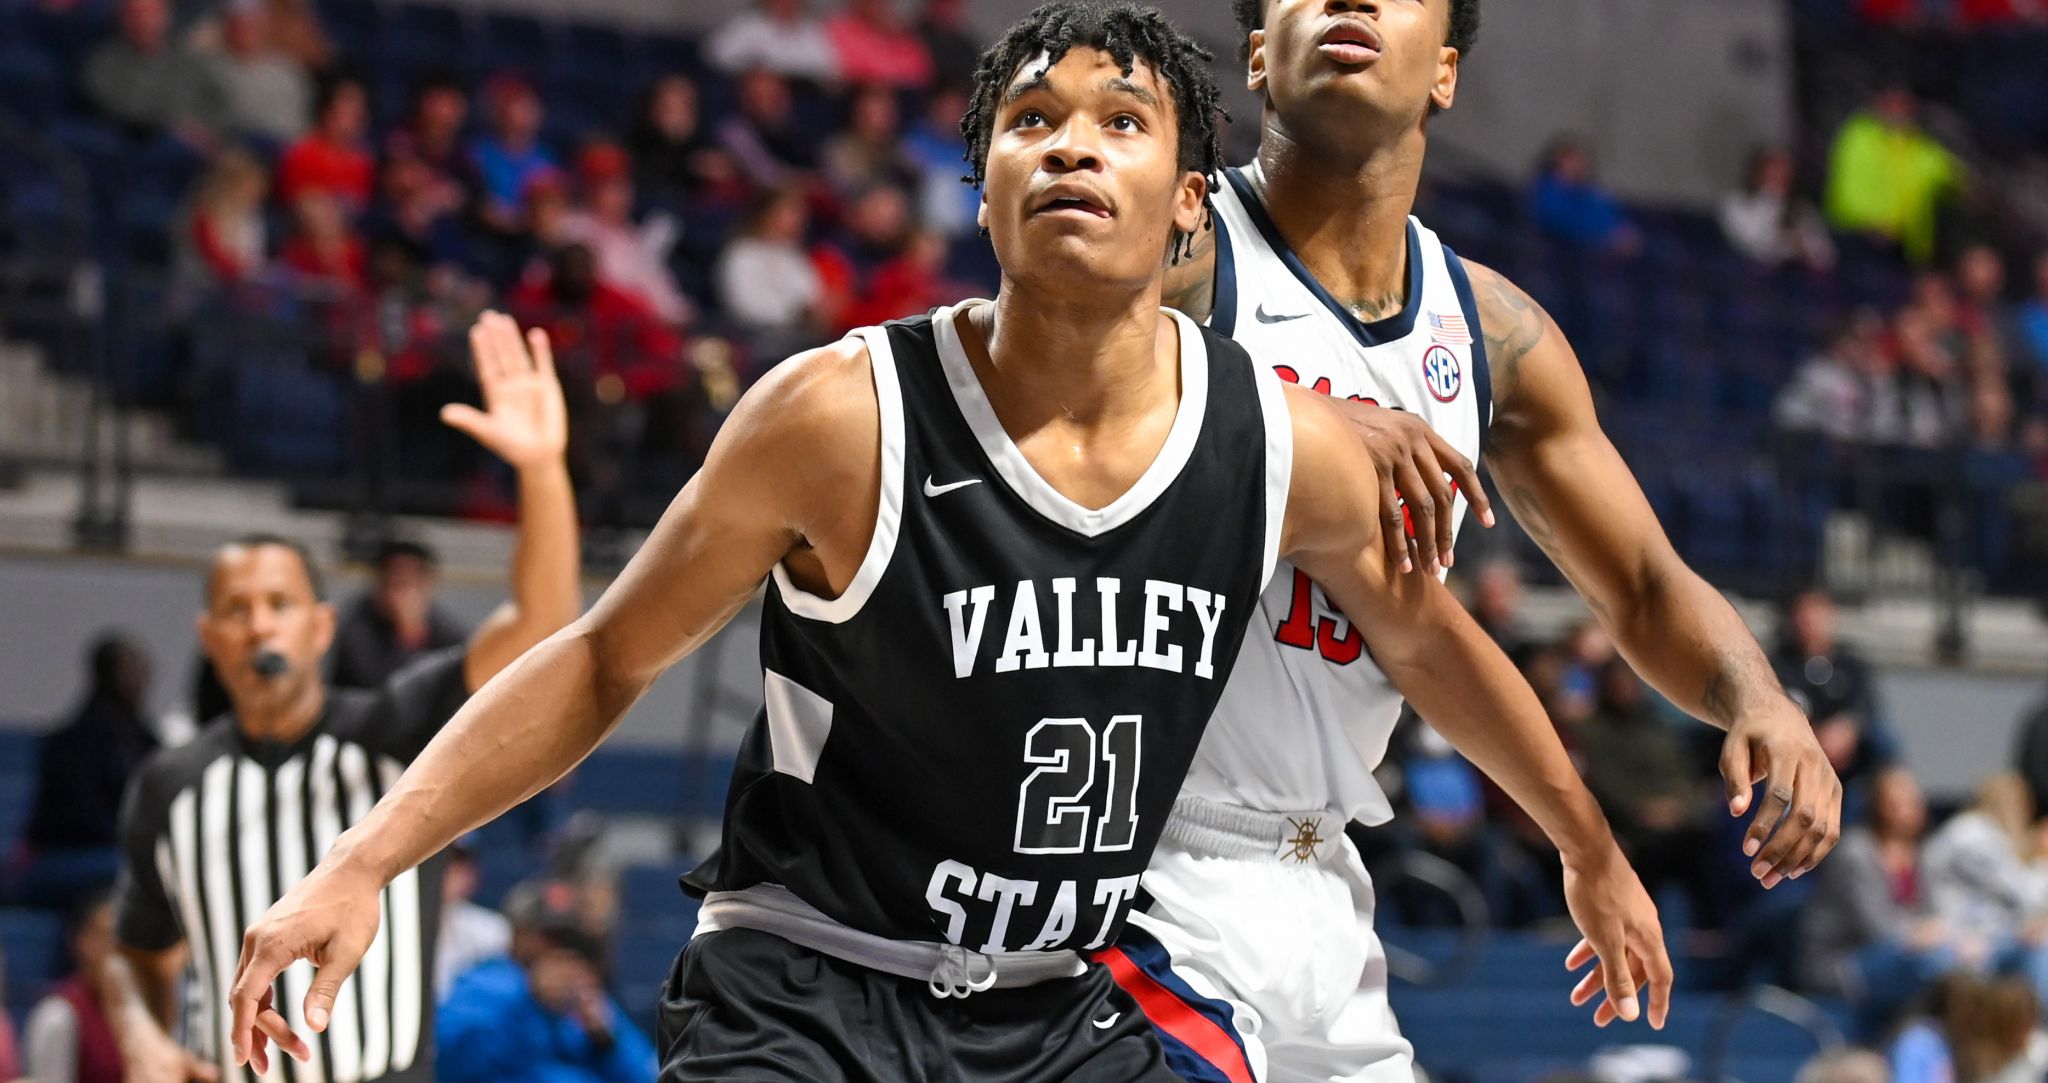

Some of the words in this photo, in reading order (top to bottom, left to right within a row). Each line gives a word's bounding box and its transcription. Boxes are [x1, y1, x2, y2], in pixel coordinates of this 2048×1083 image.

[1424, 347, 1460, 398] SEC
[943, 577, 1226, 680] VALLEY
[1013, 714, 1142, 854] 21
